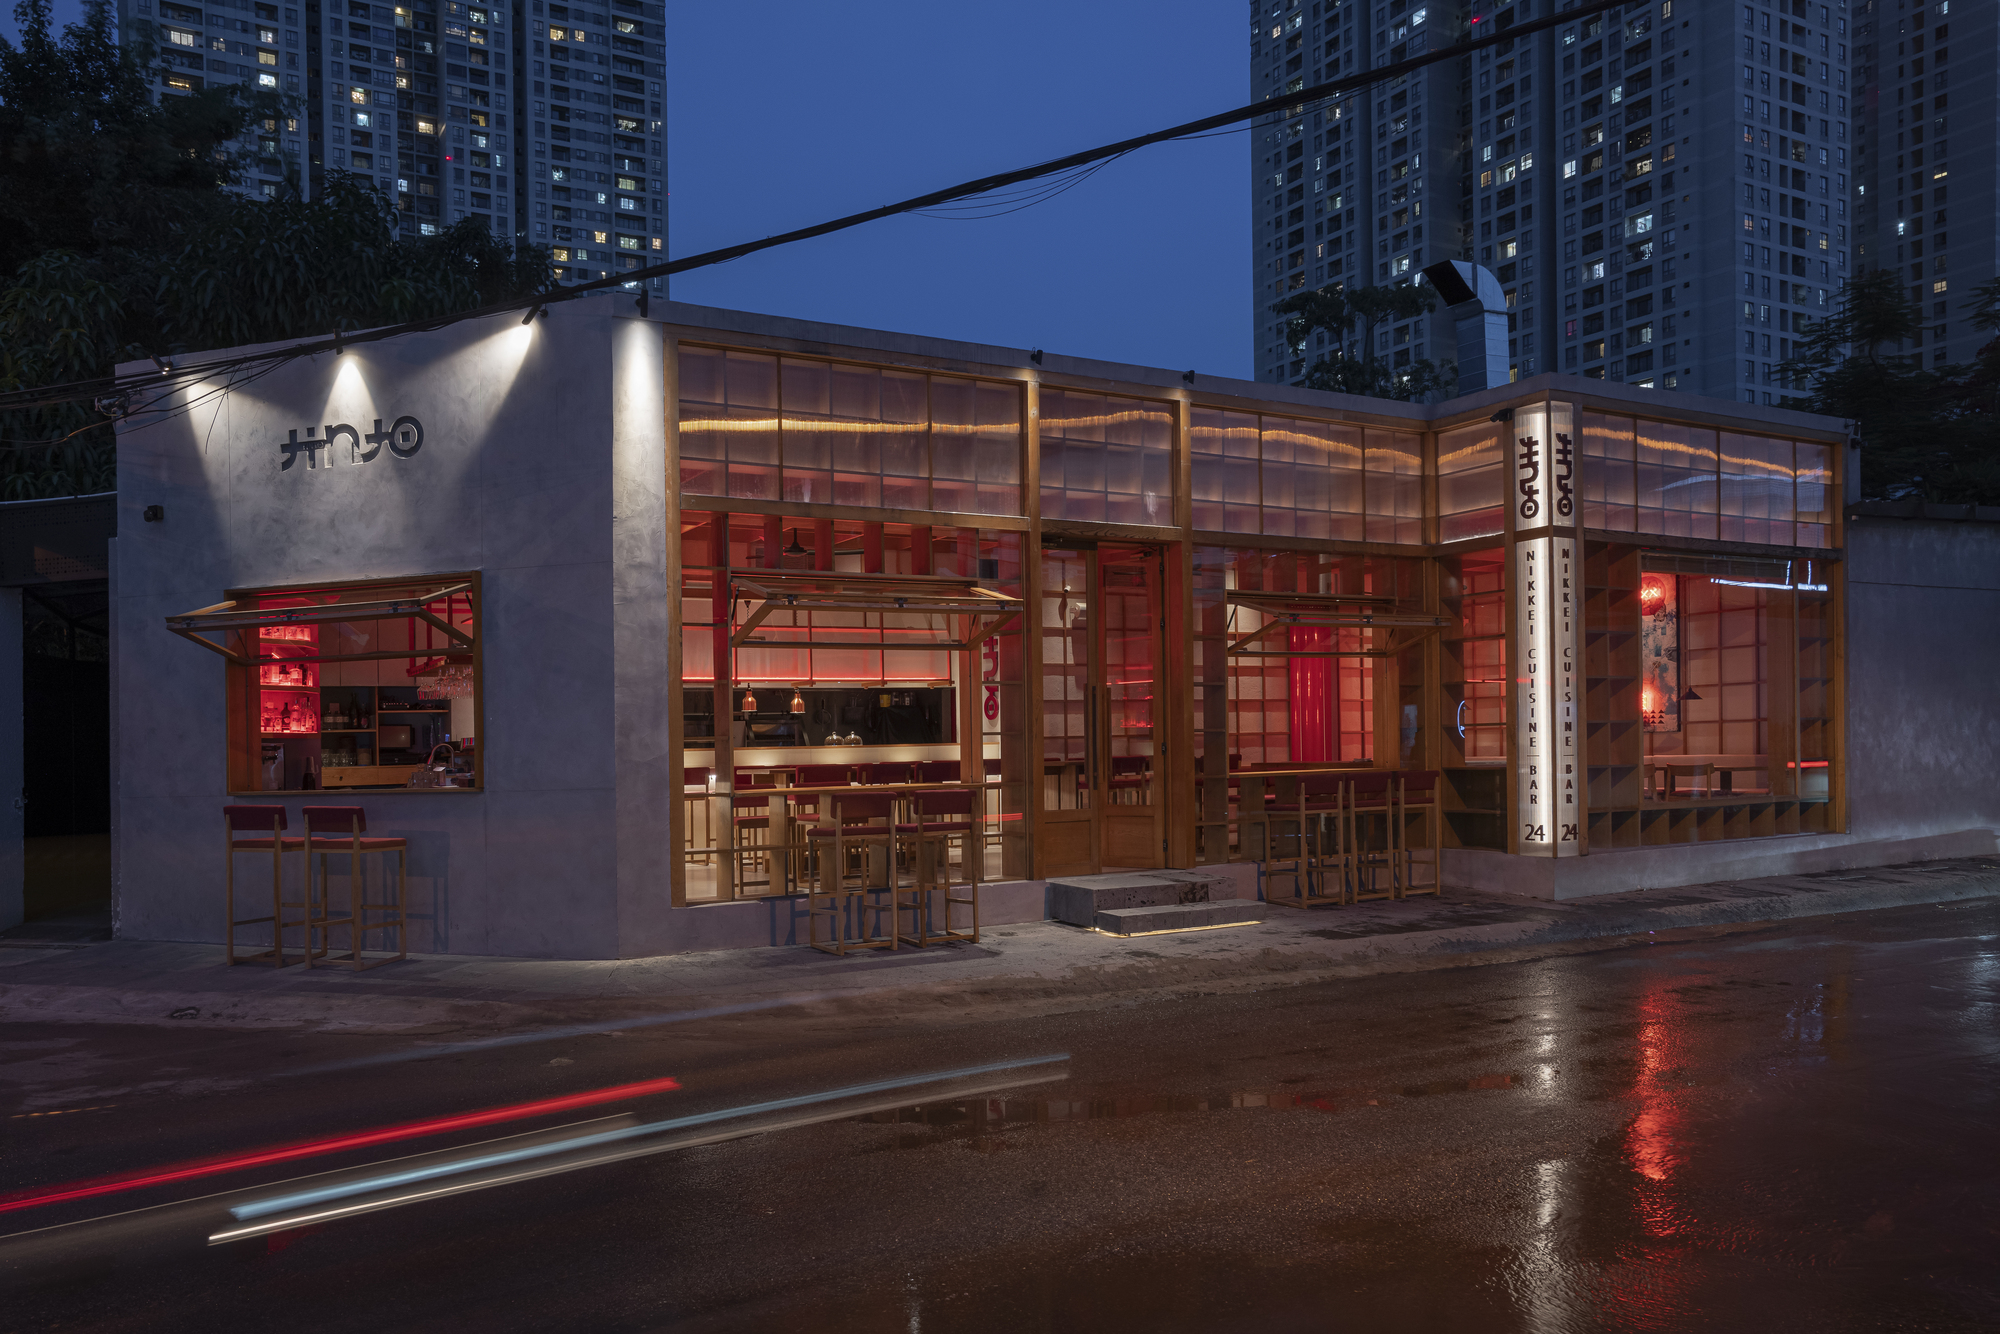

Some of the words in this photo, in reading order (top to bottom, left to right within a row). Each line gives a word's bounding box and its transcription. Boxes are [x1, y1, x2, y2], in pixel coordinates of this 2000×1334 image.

[1526, 550, 1536, 635] NIKKEI
[1562, 548, 1570, 632] NIKKEI
[1528, 648, 1537, 748] CUISINE
[1563, 647, 1572, 747] CUISINE
[1529, 764, 1538, 805] BAR
[1565, 764, 1573, 804] BAR
[1524, 823, 1546, 842] 24
[1561, 823, 1578, 842] 24
